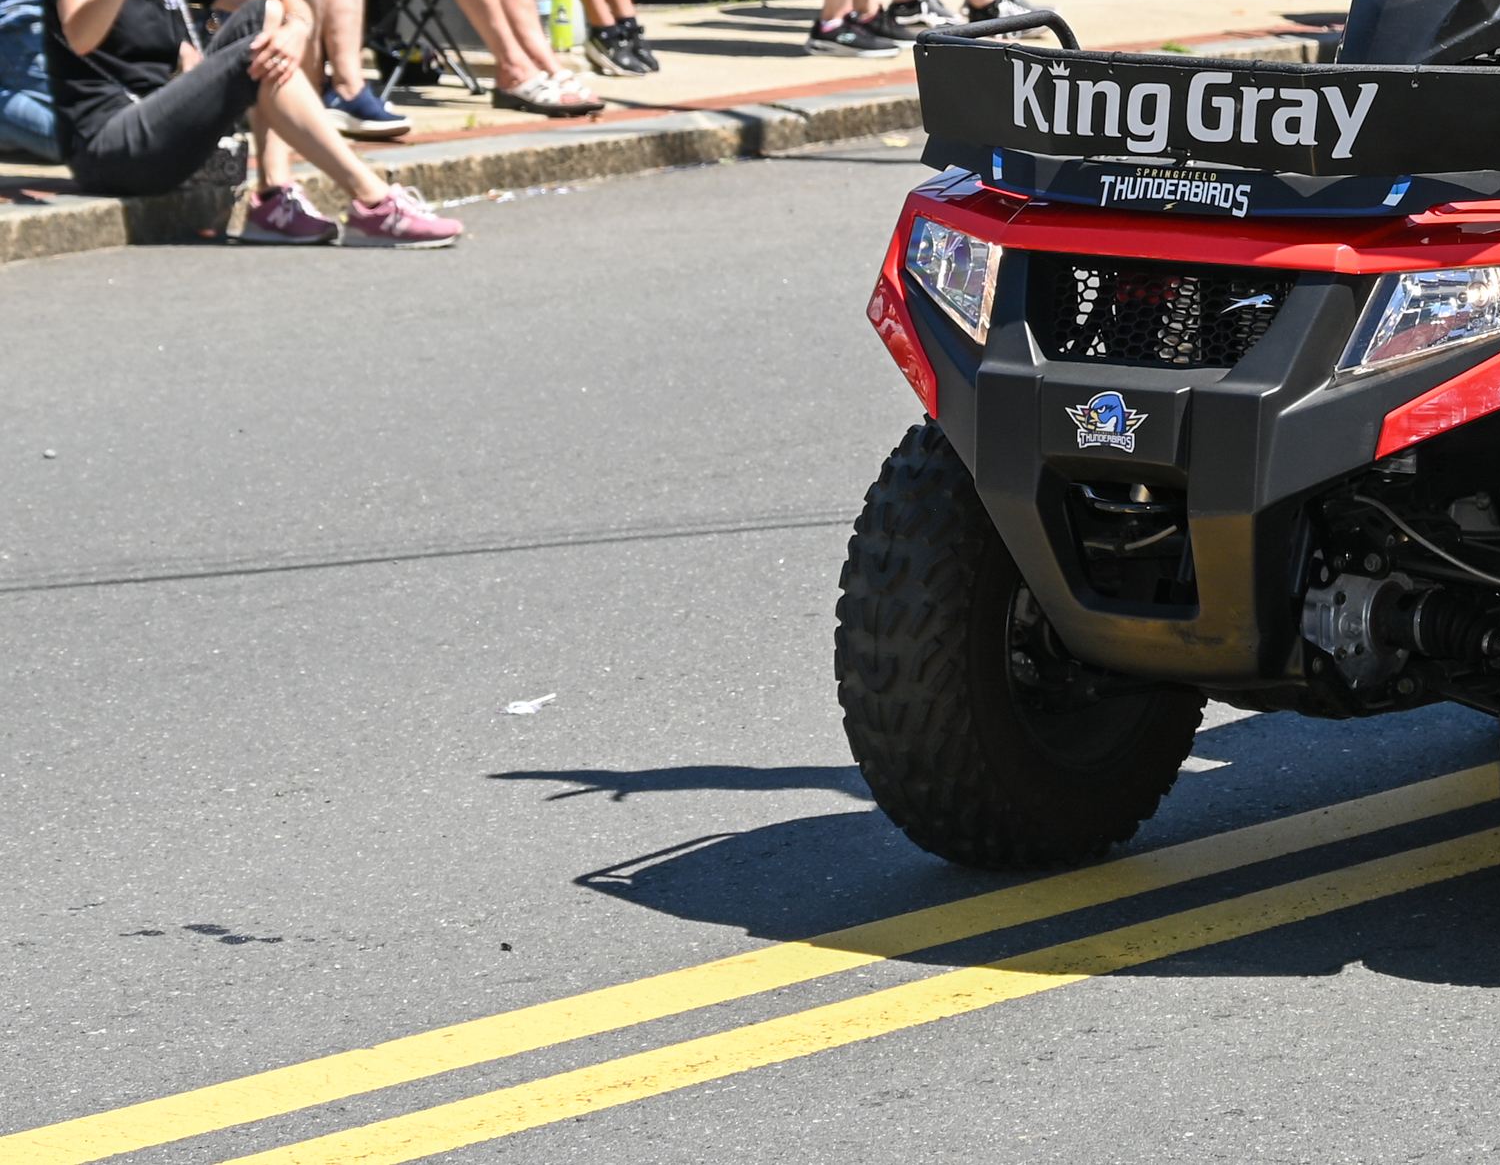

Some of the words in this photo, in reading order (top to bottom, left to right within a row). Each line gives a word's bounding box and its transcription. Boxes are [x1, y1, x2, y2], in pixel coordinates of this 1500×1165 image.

[1011, 58, 1171, 153] King
[1186, 70, 1379, 159] Gray
[1135, 167, 1218, 182] SPRINGFIELD
[1100, 175, 1252, 218] THUNDERBIRDS
[1080, 432, 1132, 449] THUNDERBIRDS
